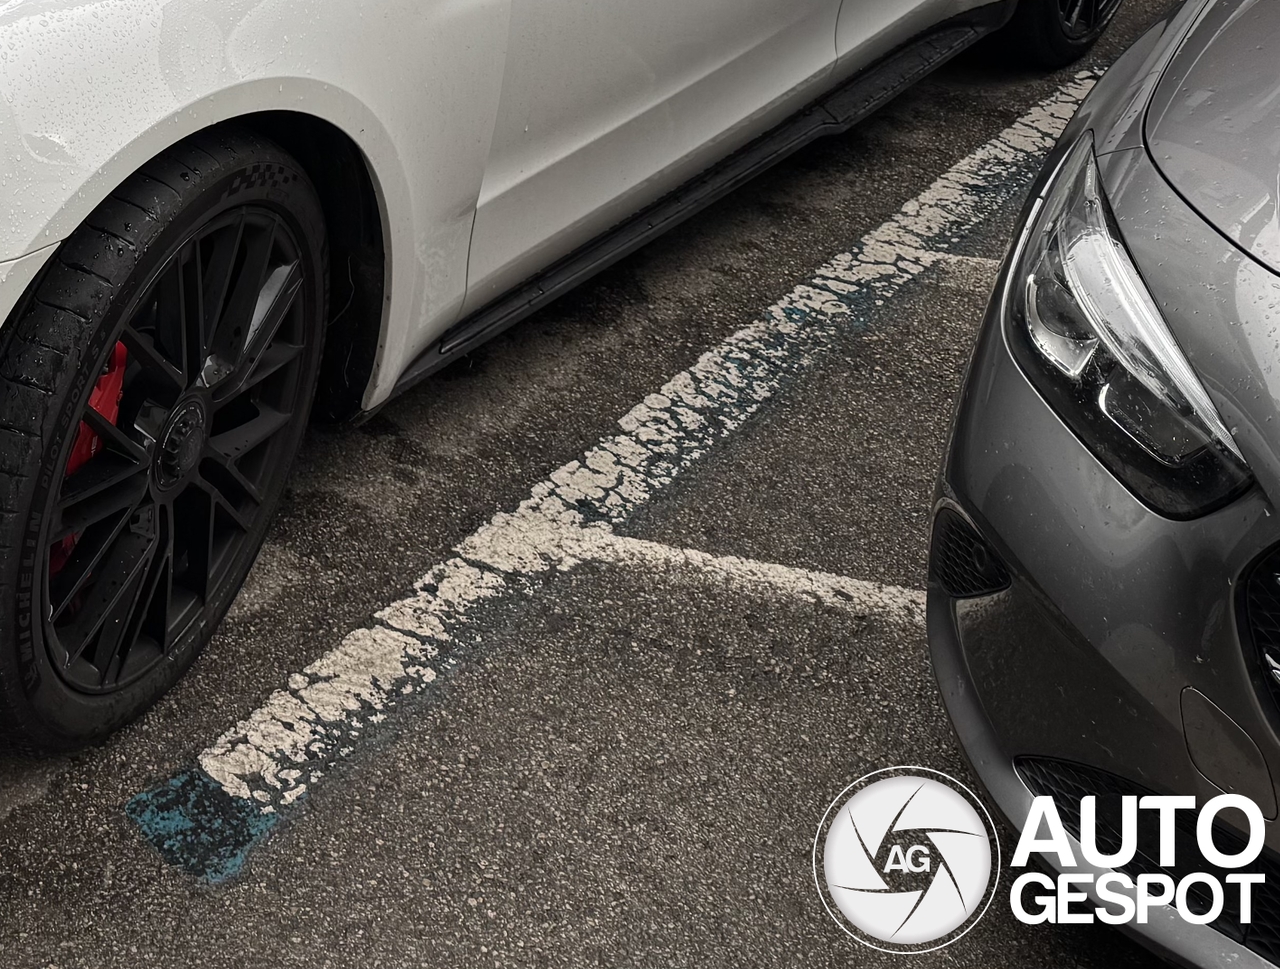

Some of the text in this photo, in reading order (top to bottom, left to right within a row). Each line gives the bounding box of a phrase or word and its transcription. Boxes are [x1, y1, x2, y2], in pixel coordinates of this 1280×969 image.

[40, 435, 64, 490] PILOT
[61, 365, 91, 429] SPORT
[17, 511, 42, 662] MICHELIN
